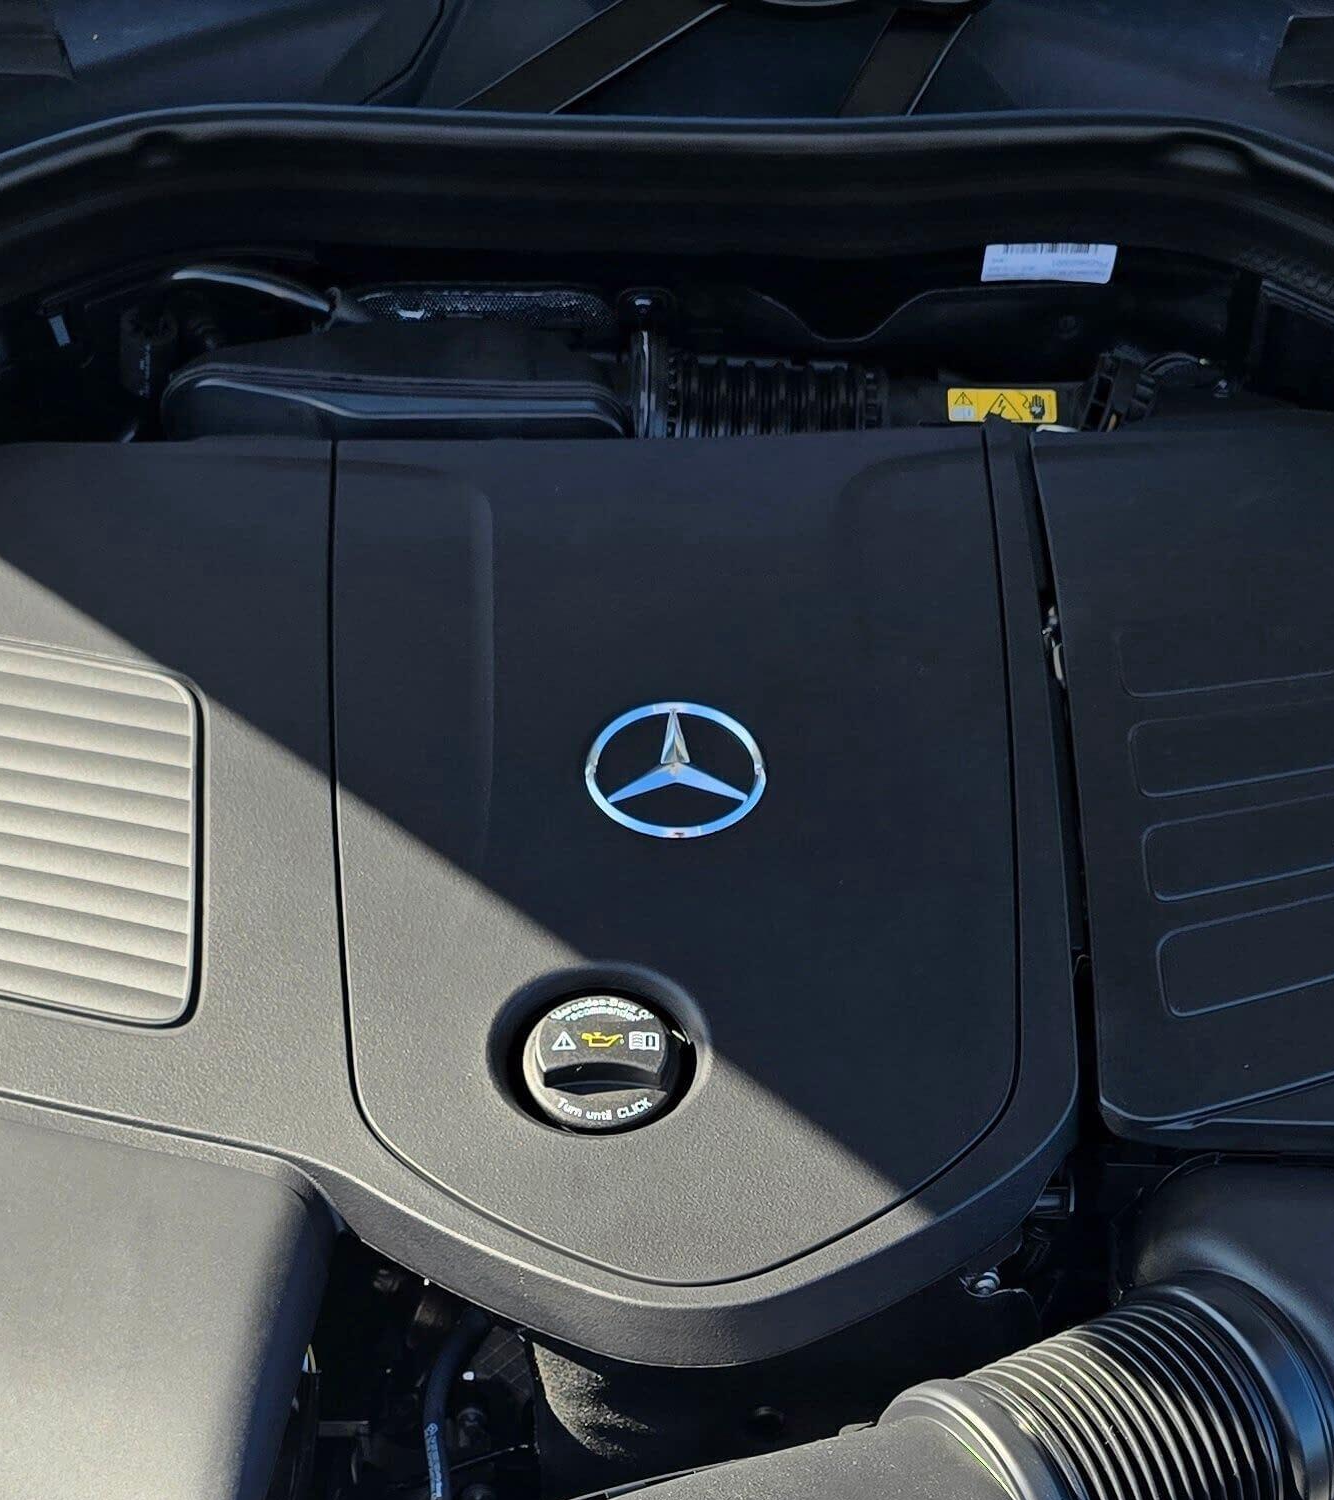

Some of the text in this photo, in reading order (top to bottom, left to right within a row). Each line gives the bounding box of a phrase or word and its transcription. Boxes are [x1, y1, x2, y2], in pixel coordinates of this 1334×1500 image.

[550, 998, 638, 1020] Mercedes-Benz
[557, 1097, 653, 1121] Turn until CLICK
